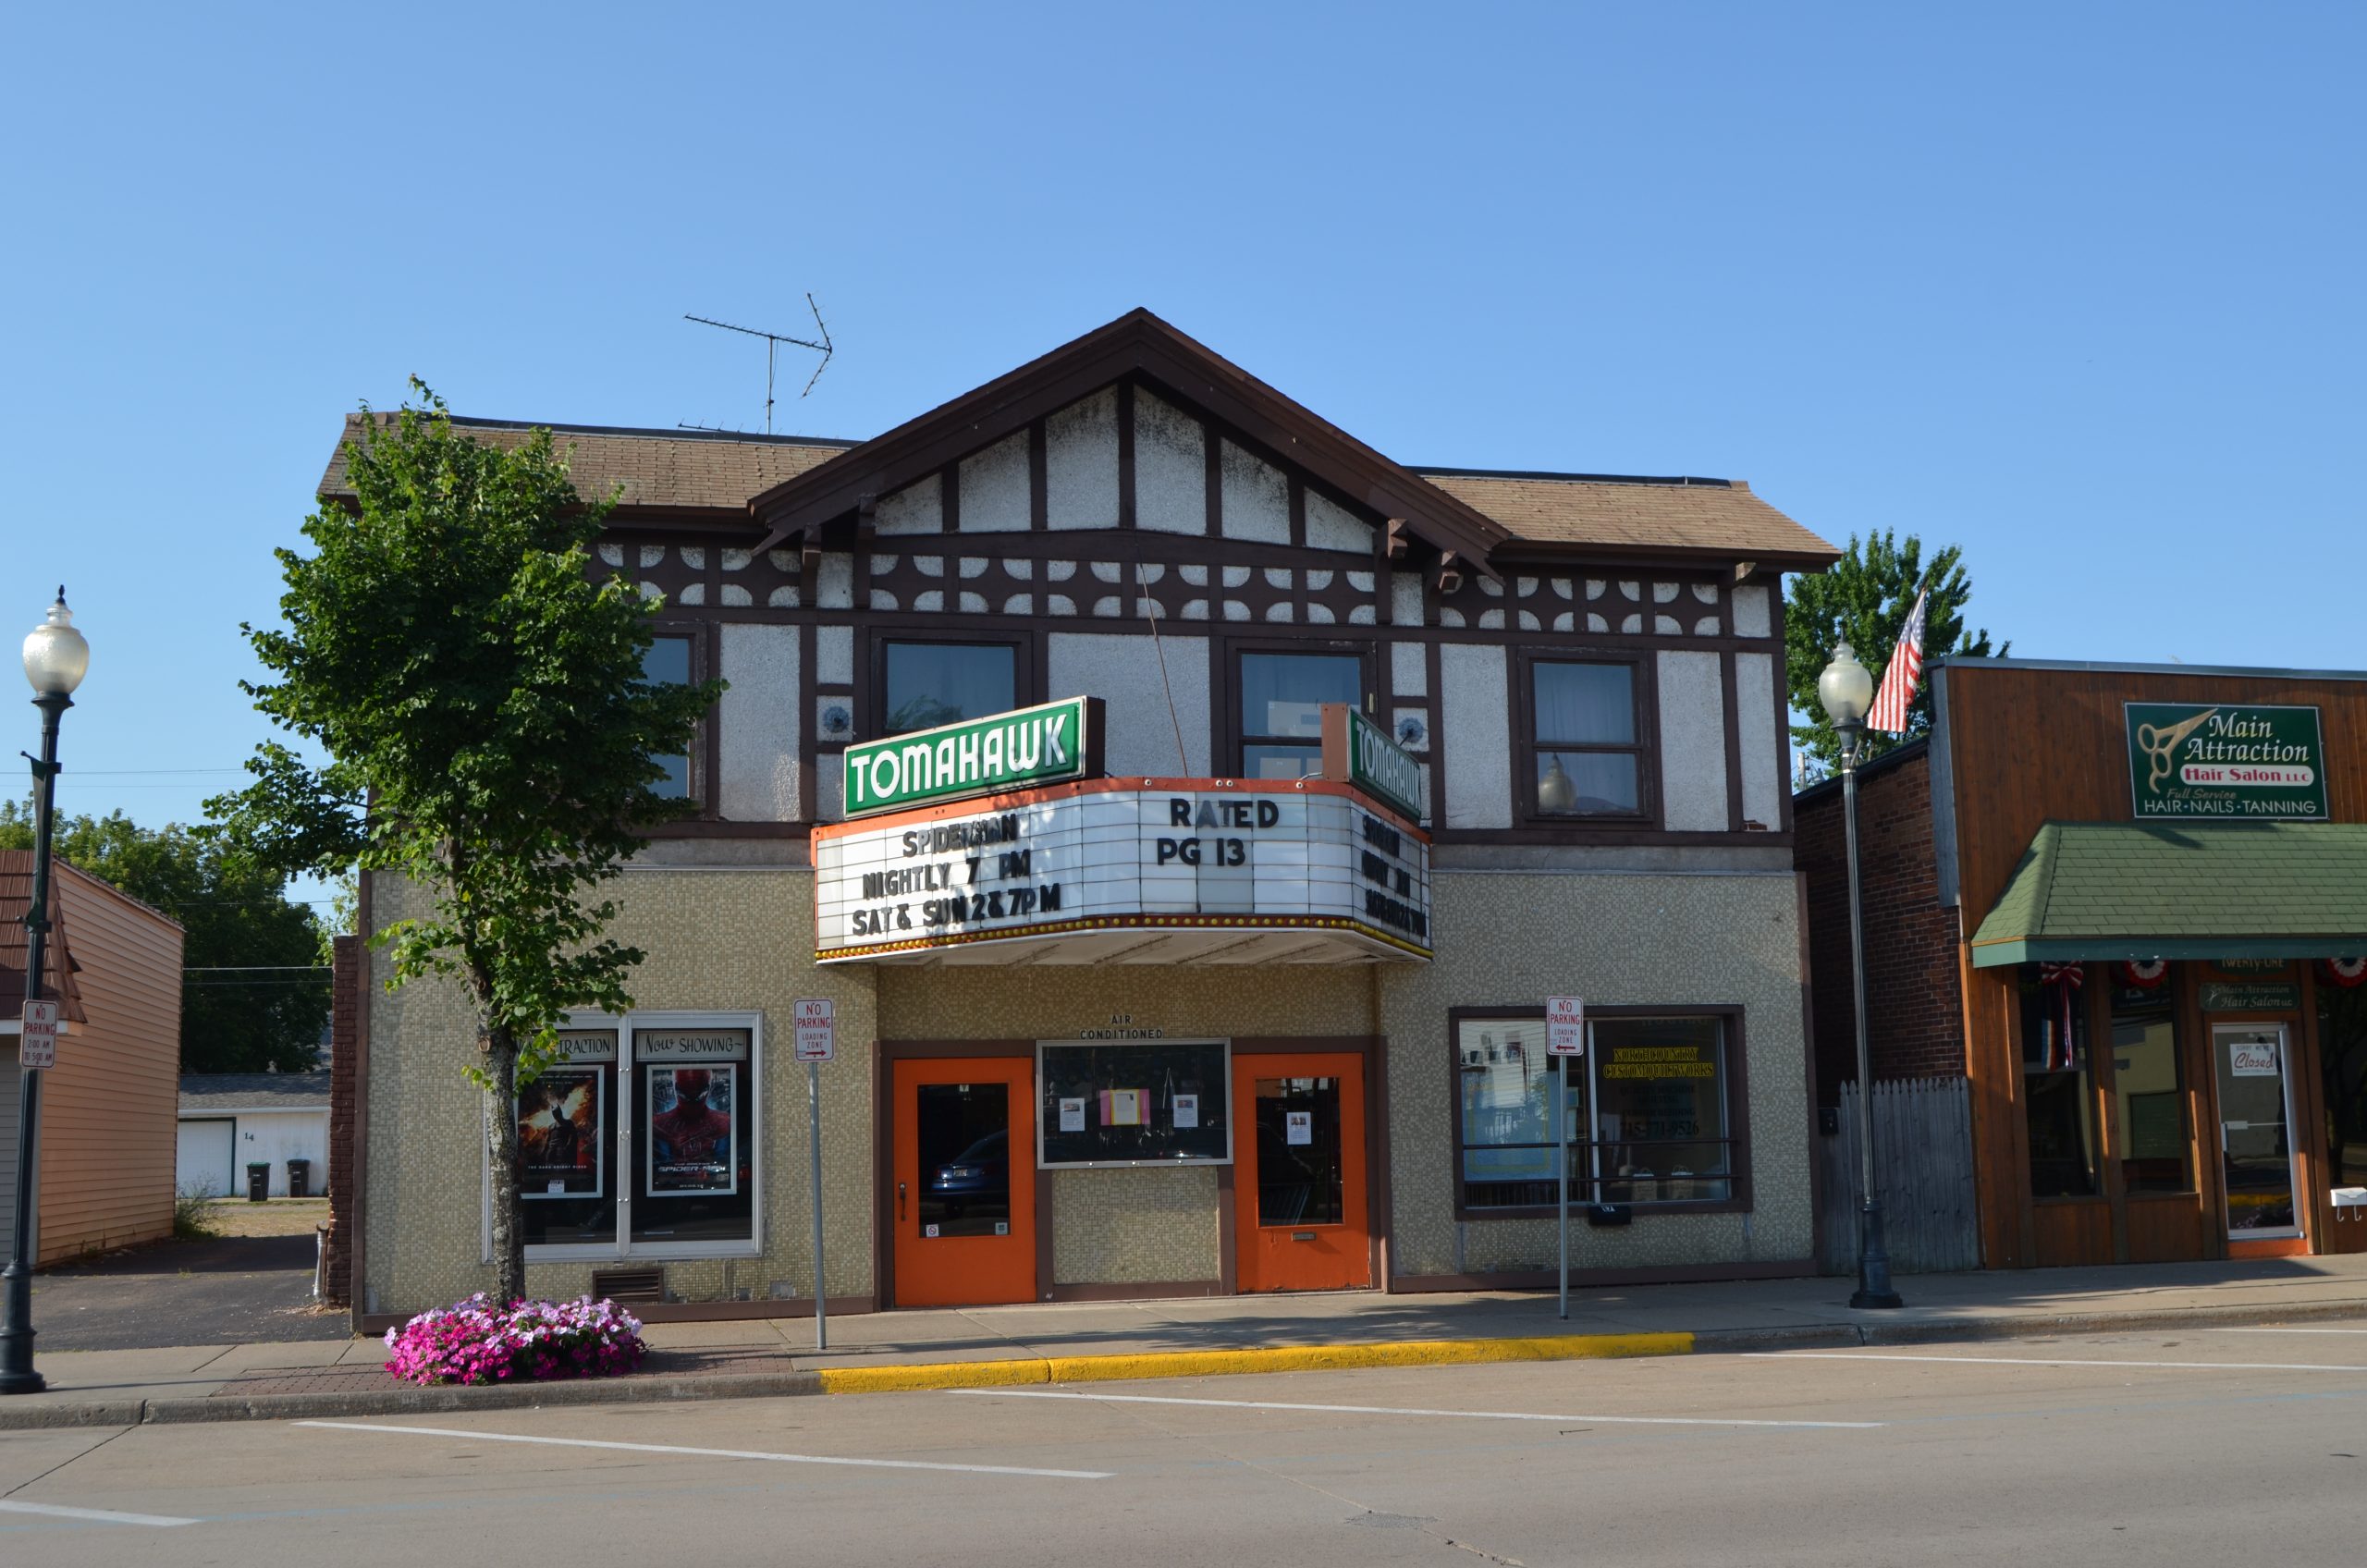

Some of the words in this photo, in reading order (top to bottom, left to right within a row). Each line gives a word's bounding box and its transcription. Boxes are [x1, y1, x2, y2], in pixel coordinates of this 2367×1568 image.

[2208, 711, 2274, 738] Main
[2184, 738, 2311, 763] Attraction
[851, 714, 1067, 802] TOMAHAWK
[1356, 721, 1421, 811] TOMAHAWK
[2184, 767, 2225, 781] Hair
[2229, 768, 2282, 782] Salon
[2286, 773, 2310, 782] LLC
[2165, 788, 2191, 800] Full
[2192, 788, 2238, 800] Service
[1170, 798, 1280, 828] RATED
[2144, 799, 2183, 813] HAIR
[2189, 800, 2235, 814] NAILS
[2241, 800, 2317, 814] TANNING
[1157, 837, 1201, 866] PG
[1217, 838, 1245, 866] 13
[863, 862, 952, 900] NIGHTLY
[965, 856, 980, 885] 7
[999, 849, 1031, 881] PM
[852, 906, 892, 937] SAT
[896, 902, 913, 931] &
[923, 895, 967, 927] SUN
[1558, 1001, 1573, 1012] NO
[2220, 995, 2249, 1008] Hair
[2249, 995, 2281, 1008] Salon
[35, 1008, 46, 1020] NO
[806, 1003, 821, 1015] NO
[797, 1017, 831, 1029] PARKING
[1111, 1014, 1132, 1024] AIR
[1550, 1013, 1580, 1025] PARKING
[25, 1022, 55, 1035] PARKING
[1080, 1029, 1162, 1039] CONDITIONED
[1554, 1028, 1577, 1036] LOADING
[802, 1032, 828, 1041] LOADING
[645, 1034, 676, 1055] Now
[806, 1041, 823, 1049] ZONE
[2234, 1051, 2275, 1069] Closed
[244, 1132, 254, 1142] 14
